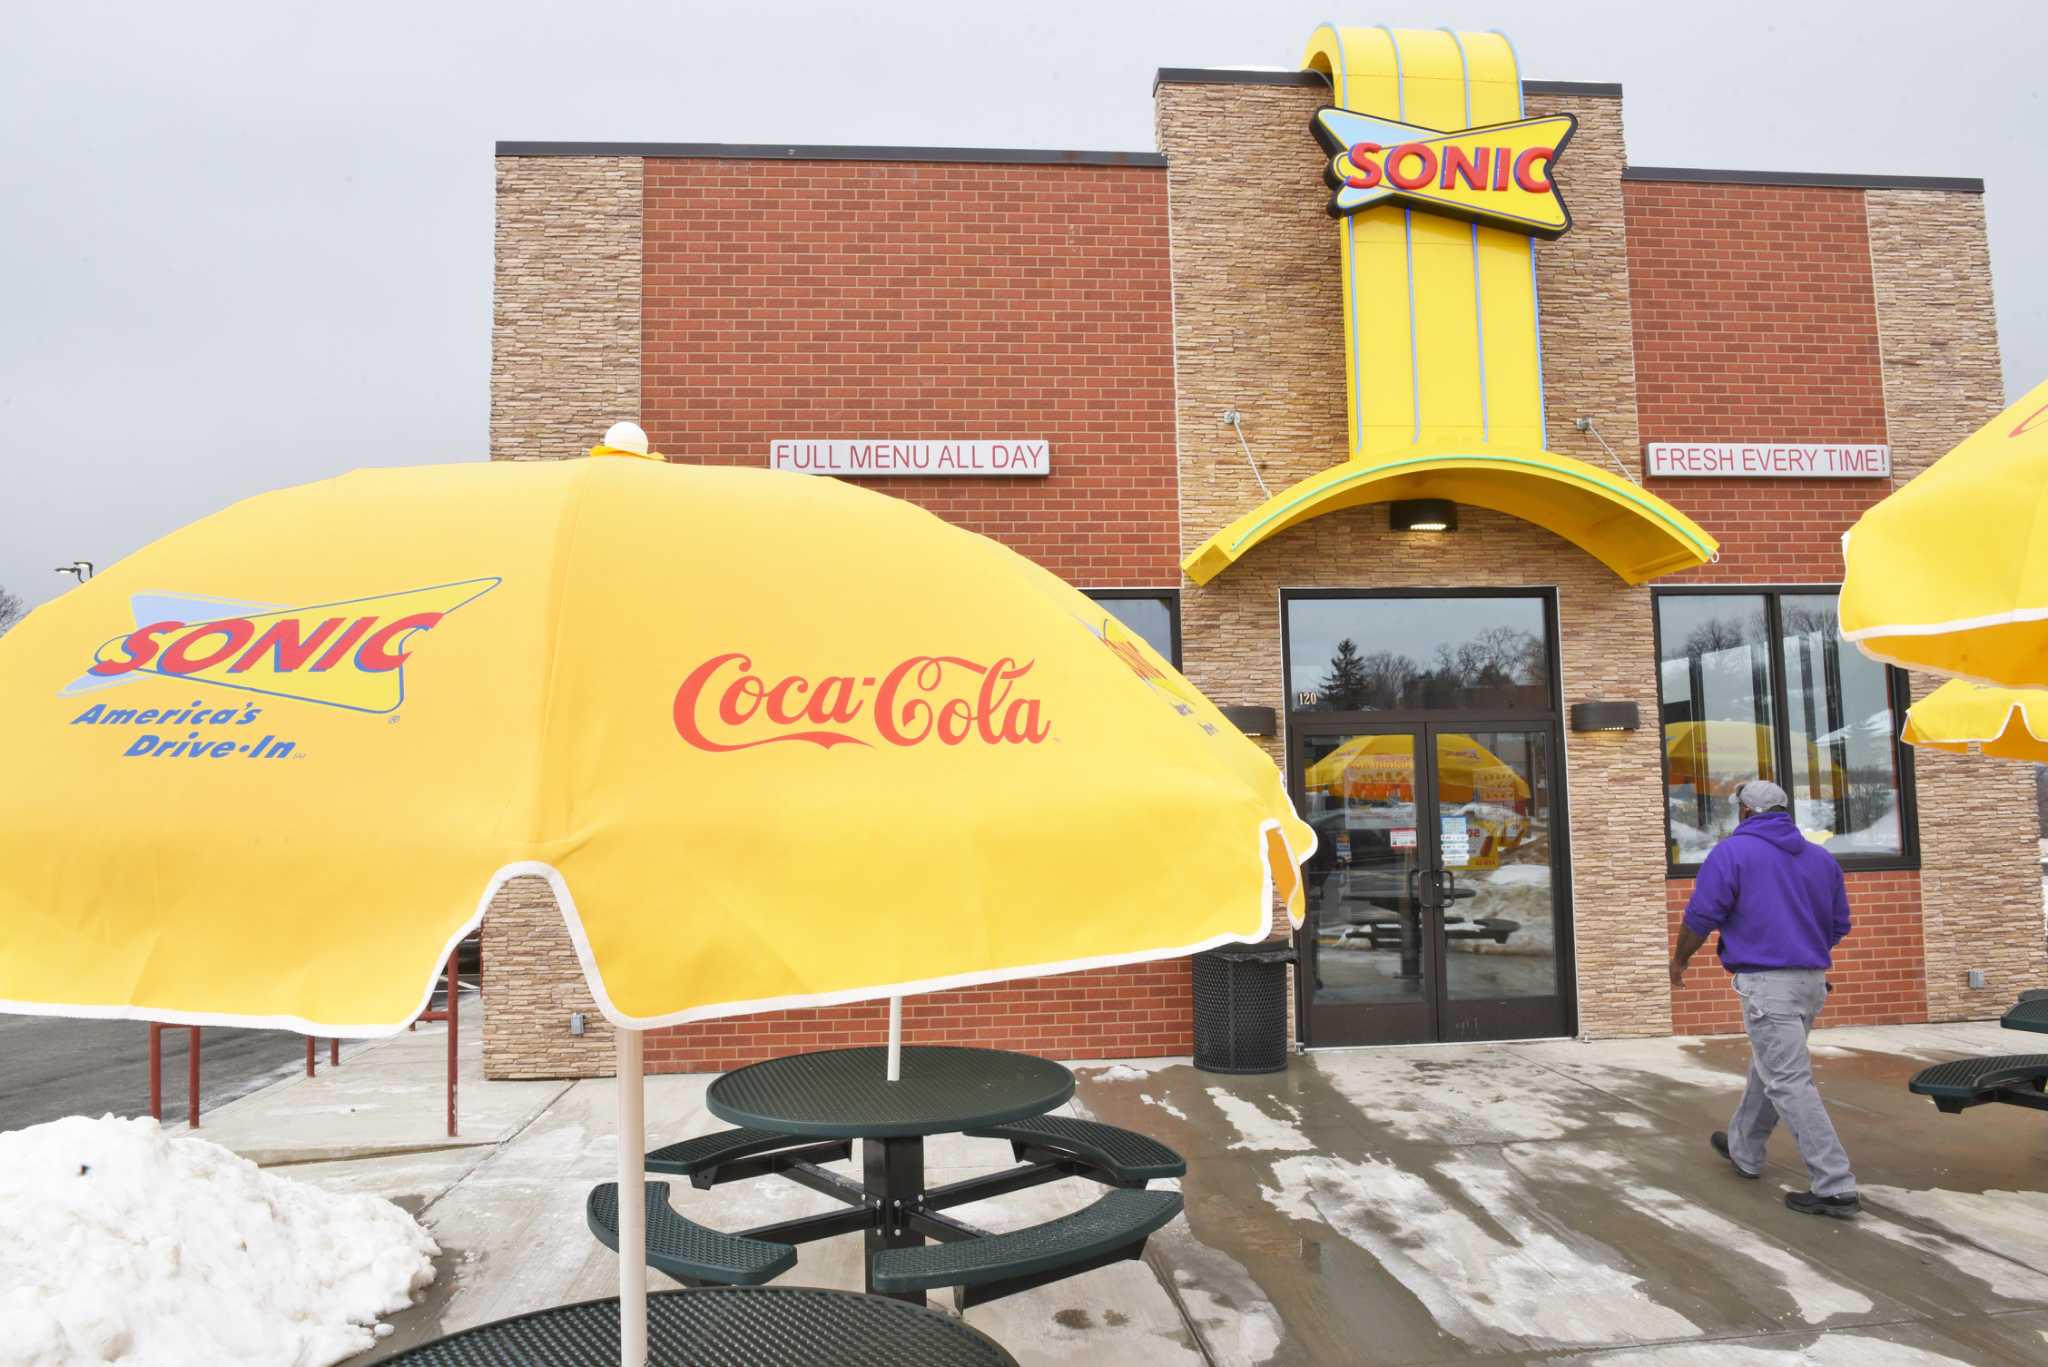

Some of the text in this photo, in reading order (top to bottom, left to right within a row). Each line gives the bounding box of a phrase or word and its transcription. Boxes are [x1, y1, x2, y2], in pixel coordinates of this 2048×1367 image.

[1344, 142, 1553, 193] SONIC
[776, 444, 1044, 469] FULL MENU ALL DAY
[1655, 447, 1887, 473] FRESH EVERY TIME!
[87, 611, 446, 677] SONIC
[673, 652, 1052, 753] Coca-Cola
[1299, 691, 1317, 705] 120
[69, 699, 264, 726] America's
